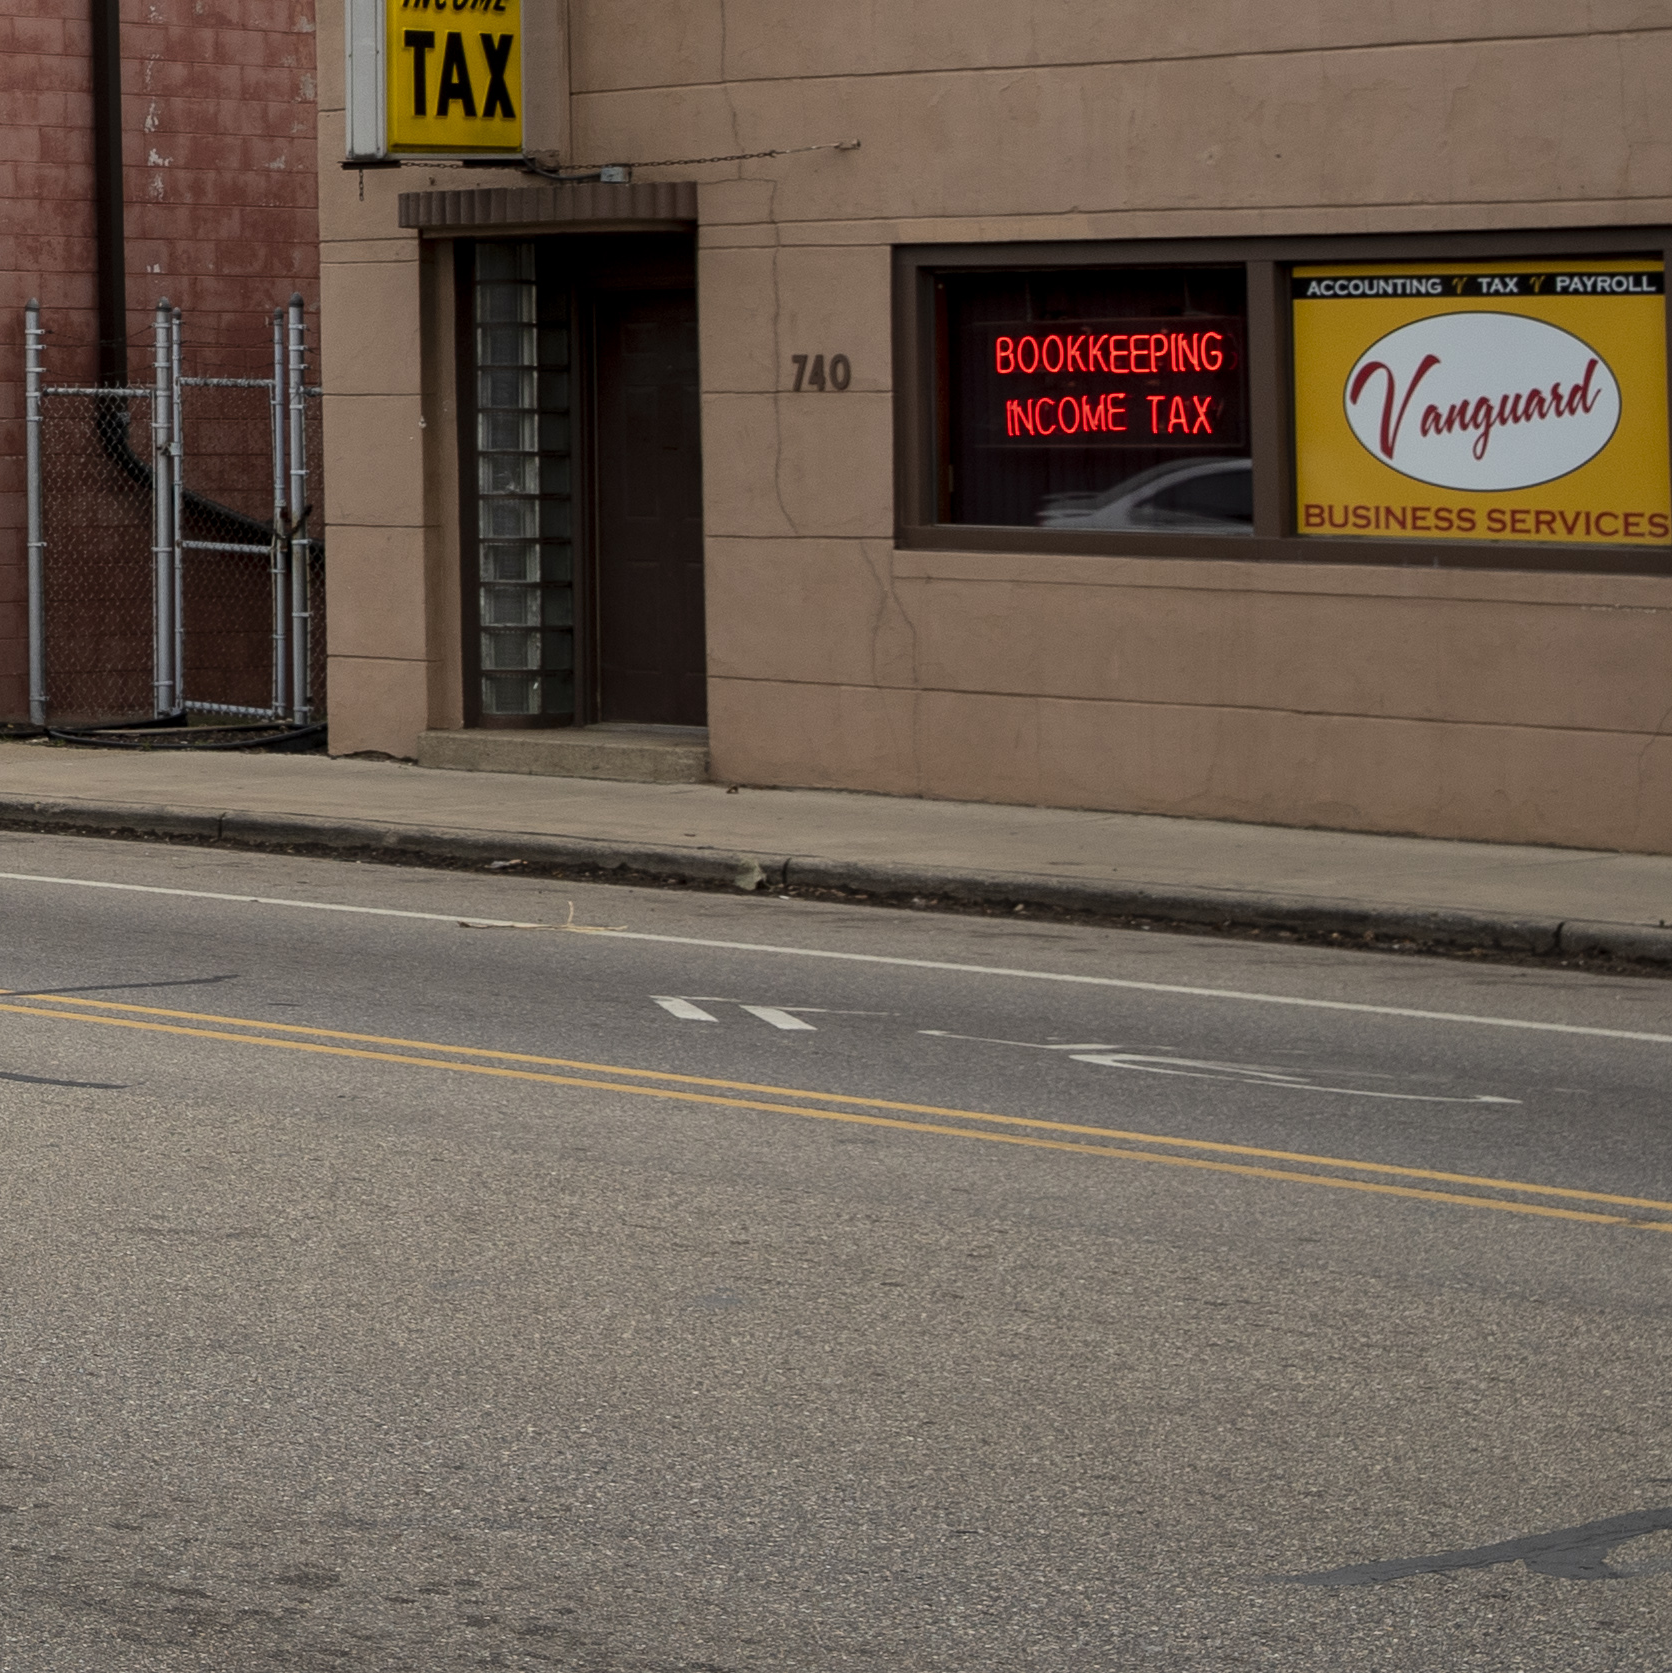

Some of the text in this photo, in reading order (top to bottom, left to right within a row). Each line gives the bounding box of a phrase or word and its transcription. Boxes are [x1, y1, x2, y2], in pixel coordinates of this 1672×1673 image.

[403, 30, 517, 119] TAX
[1307, 276, 1656, 296] ACCOUNTING TAX PAYROLL
[791, 353, 851, 392] 740
[996, 331, 1224, 374] BOOKKEEPING
[1006, 393, 1212, 437] INCOME TAX
[1349, 354, 1602, 461] Vanguard
[1304, 504, 1670, 539] BUSINESS SERVICES
